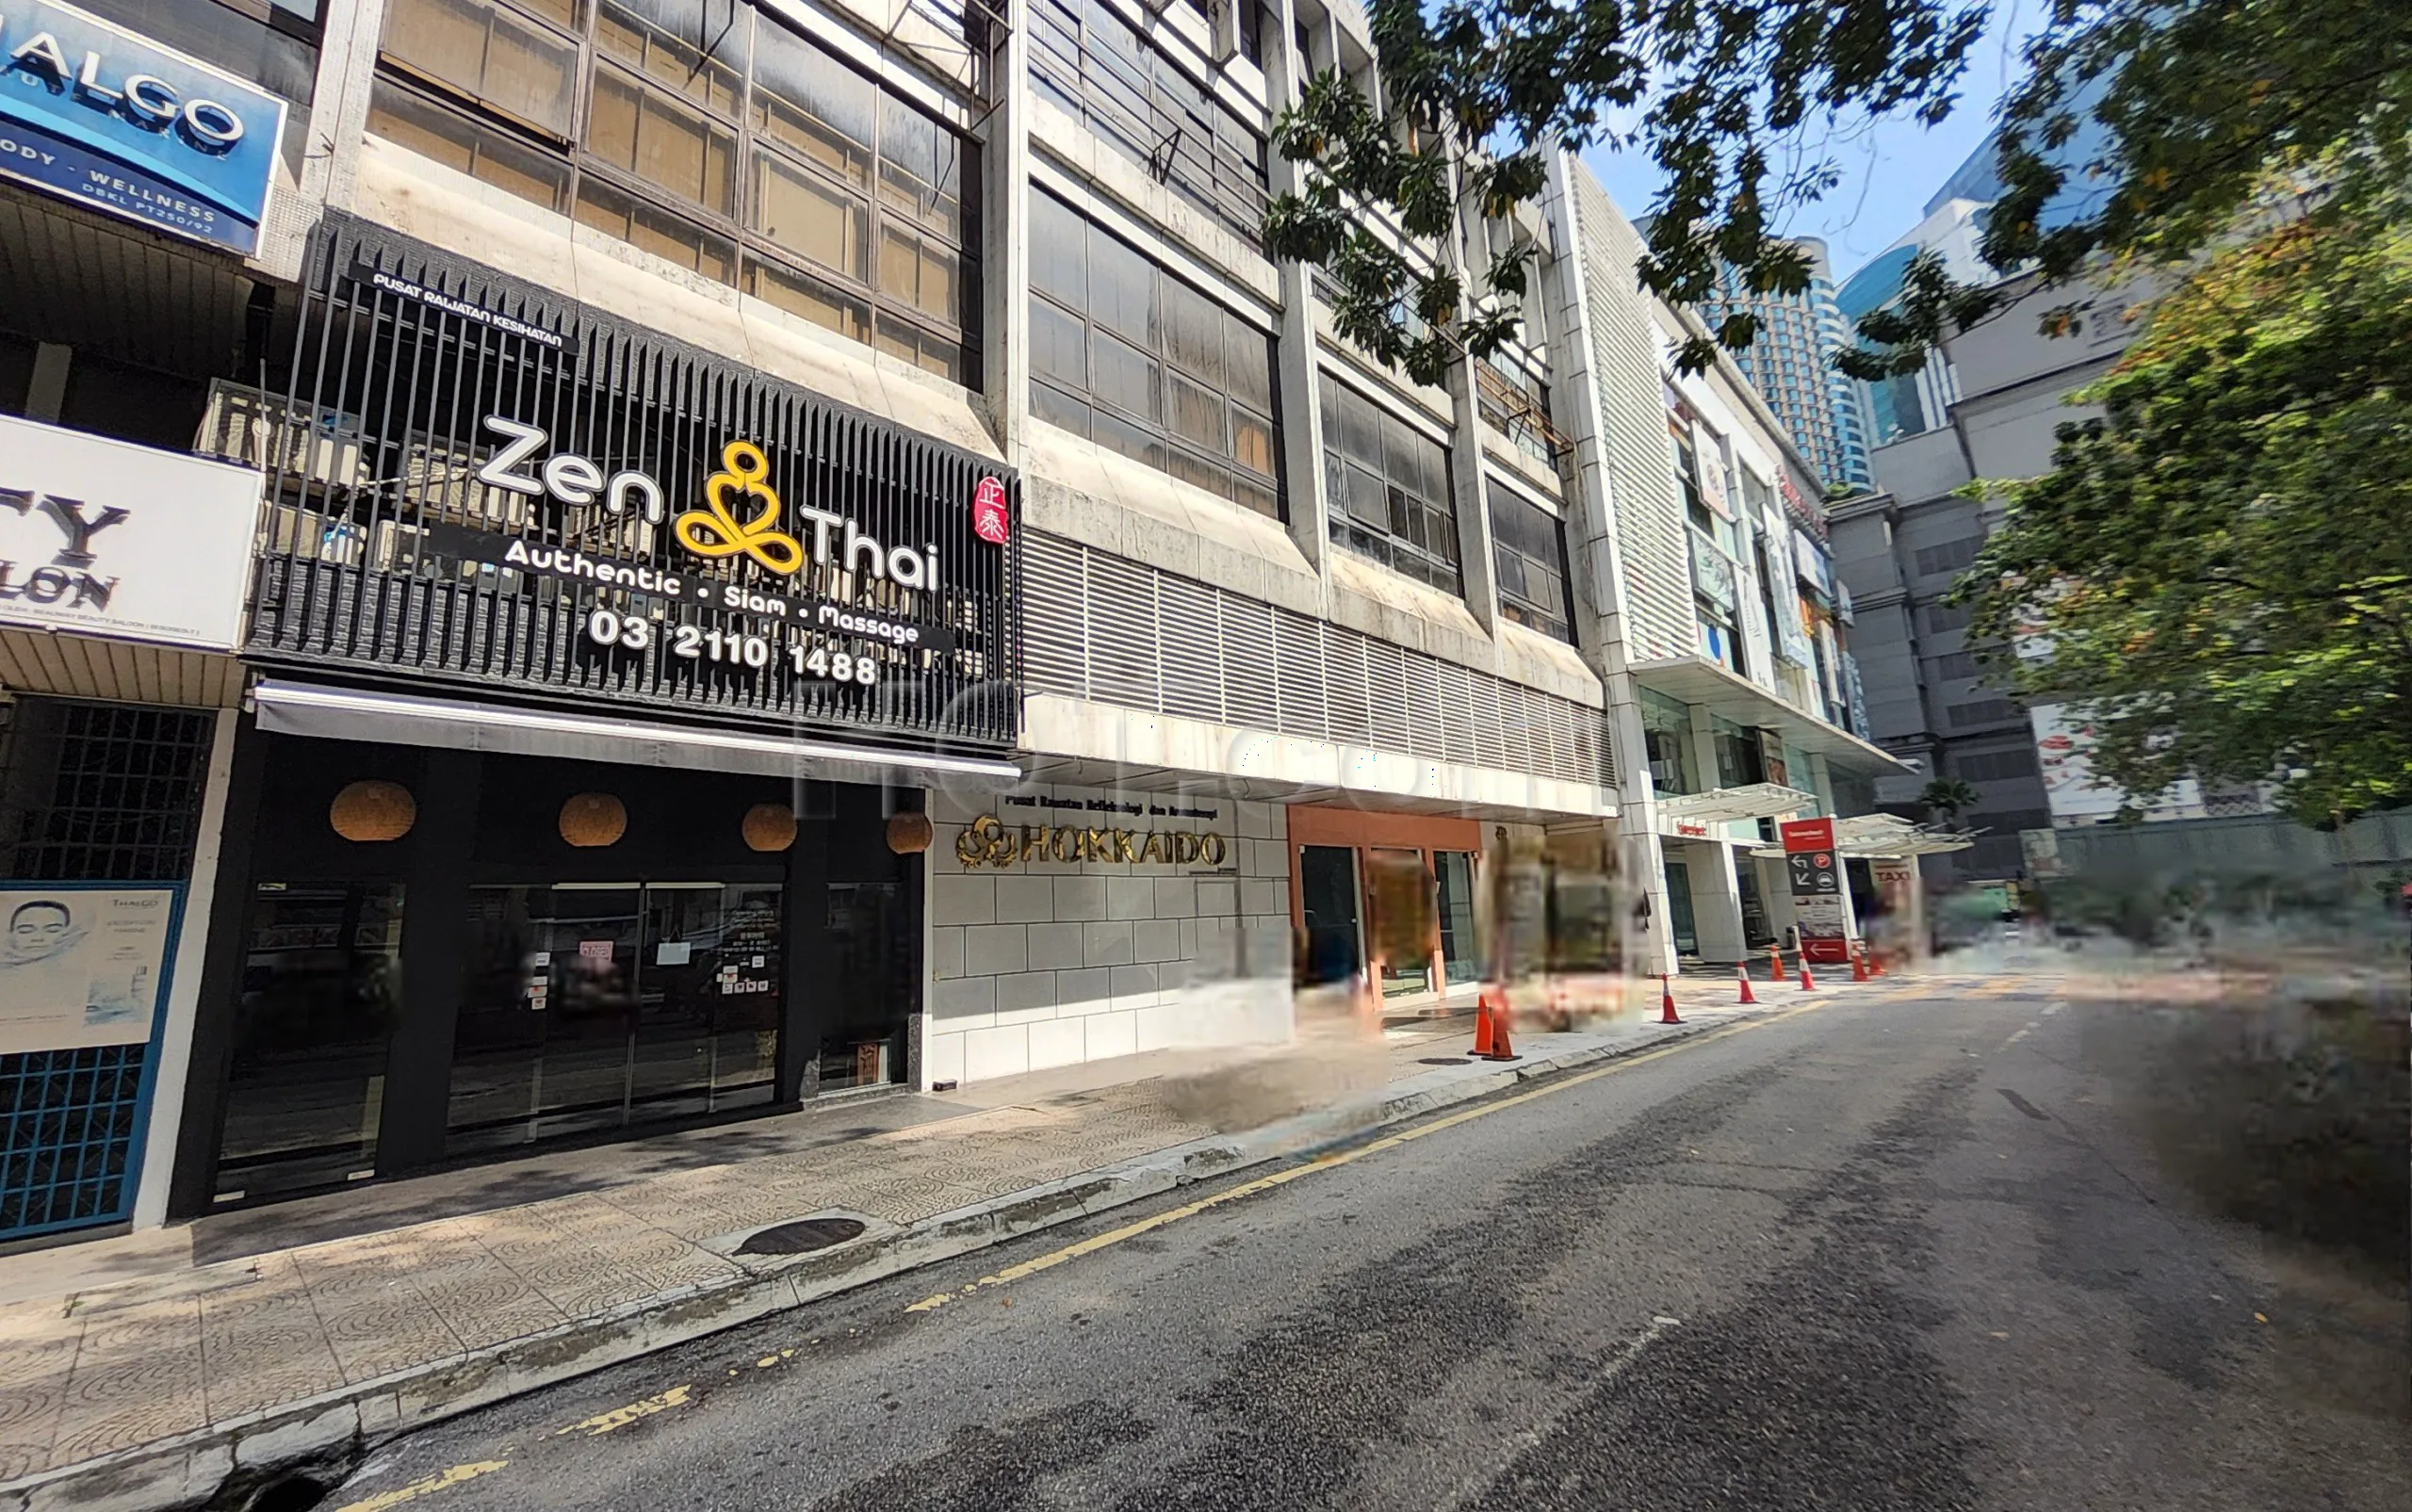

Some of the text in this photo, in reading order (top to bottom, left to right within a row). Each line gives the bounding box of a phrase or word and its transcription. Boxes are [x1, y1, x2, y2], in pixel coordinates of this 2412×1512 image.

[0, 13, 244, 142] ALGO
[82, 184, 213, 234] DBKL PT250/92
[90, 170, 215, 222] WELLNESS
[373, 273, 562, 348] PUSAT RAWATAN KESIHATAN
[478, 414, 938, 593] Zen Thai
[979, 480, 1006, 539] 正泰
[505, 540, 919, 645] Authentic Siam Massage
[589, 609, 877, 686] 03 2110 1488
[1020, 824, 1226, 866] HOKKAIDO
[1876, 871, 1910, 882] TAXI
